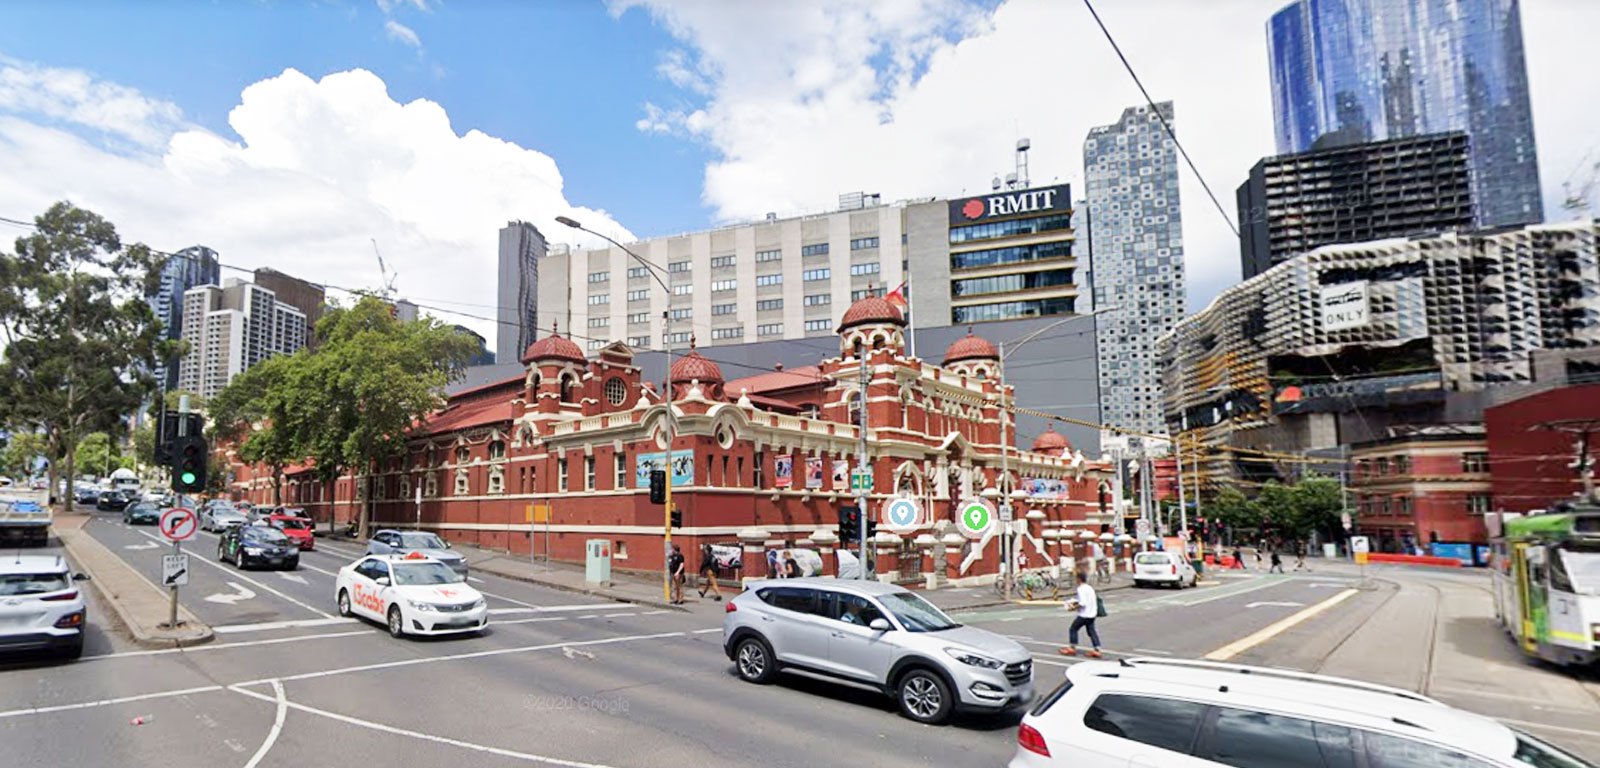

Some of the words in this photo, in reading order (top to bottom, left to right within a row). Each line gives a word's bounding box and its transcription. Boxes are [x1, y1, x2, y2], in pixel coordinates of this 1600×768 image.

[987, 189, 1057, 216] RMIT
[1326, 309, 1364, 325] ONLY
[353, 583, 385, 615] 13cabs
